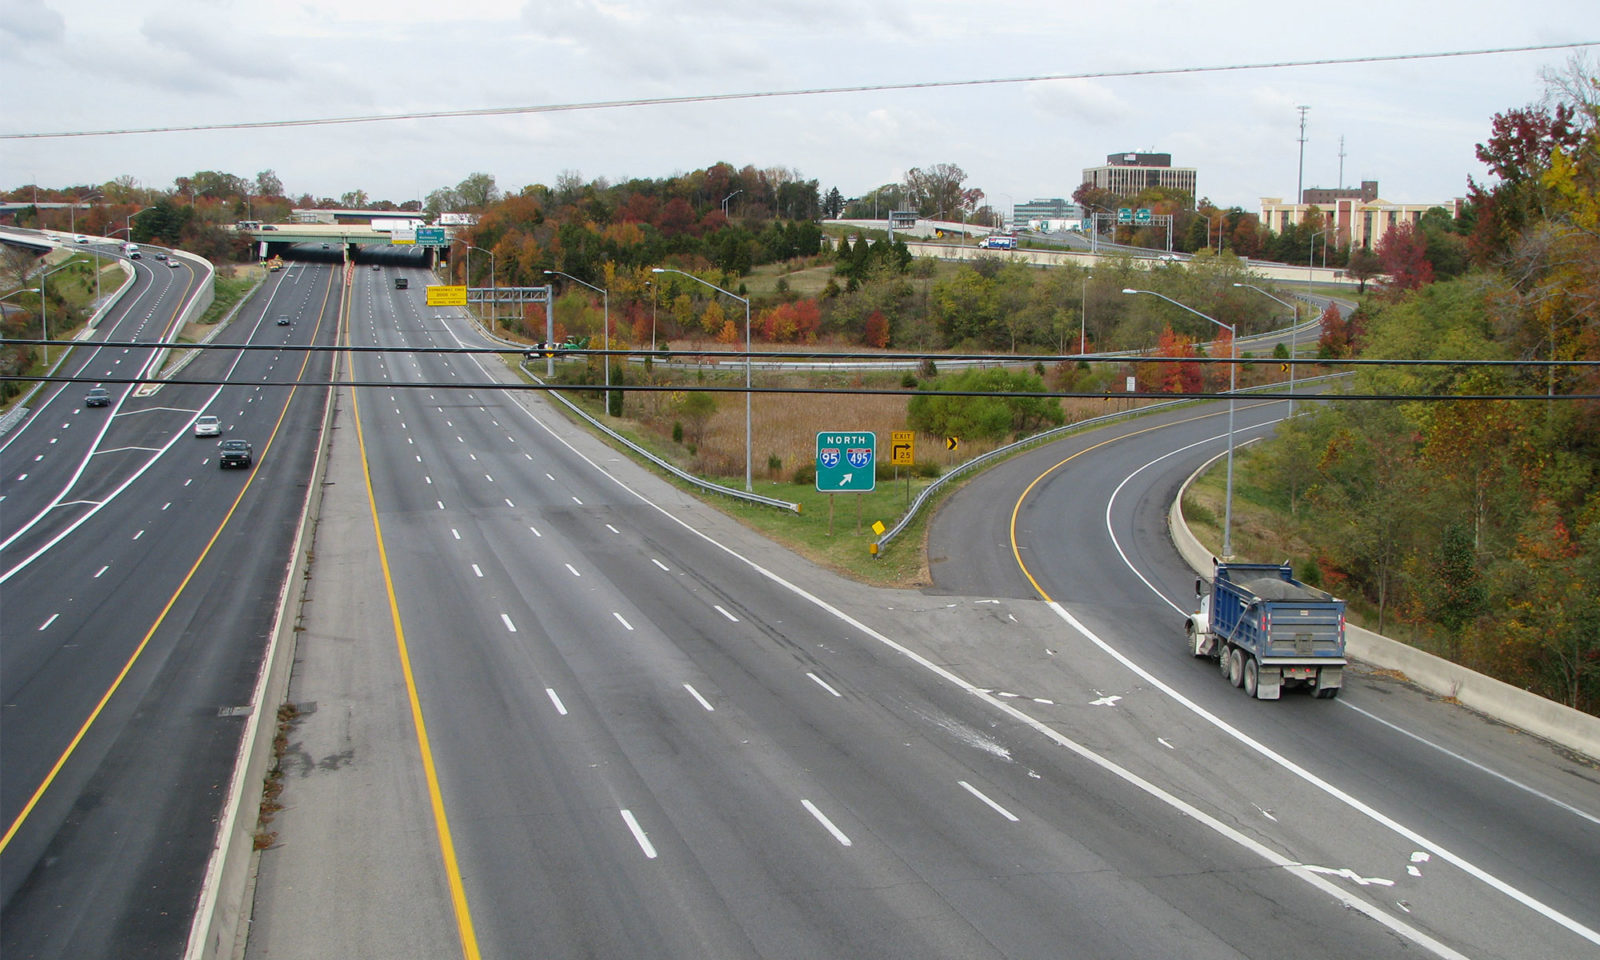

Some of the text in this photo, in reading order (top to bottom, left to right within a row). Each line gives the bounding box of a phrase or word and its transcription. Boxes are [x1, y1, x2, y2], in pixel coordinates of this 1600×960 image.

[827, 436, 865, 444] NORTH
[822, 453, 837, 464] 95
[850, 453, 868, 464] 495
